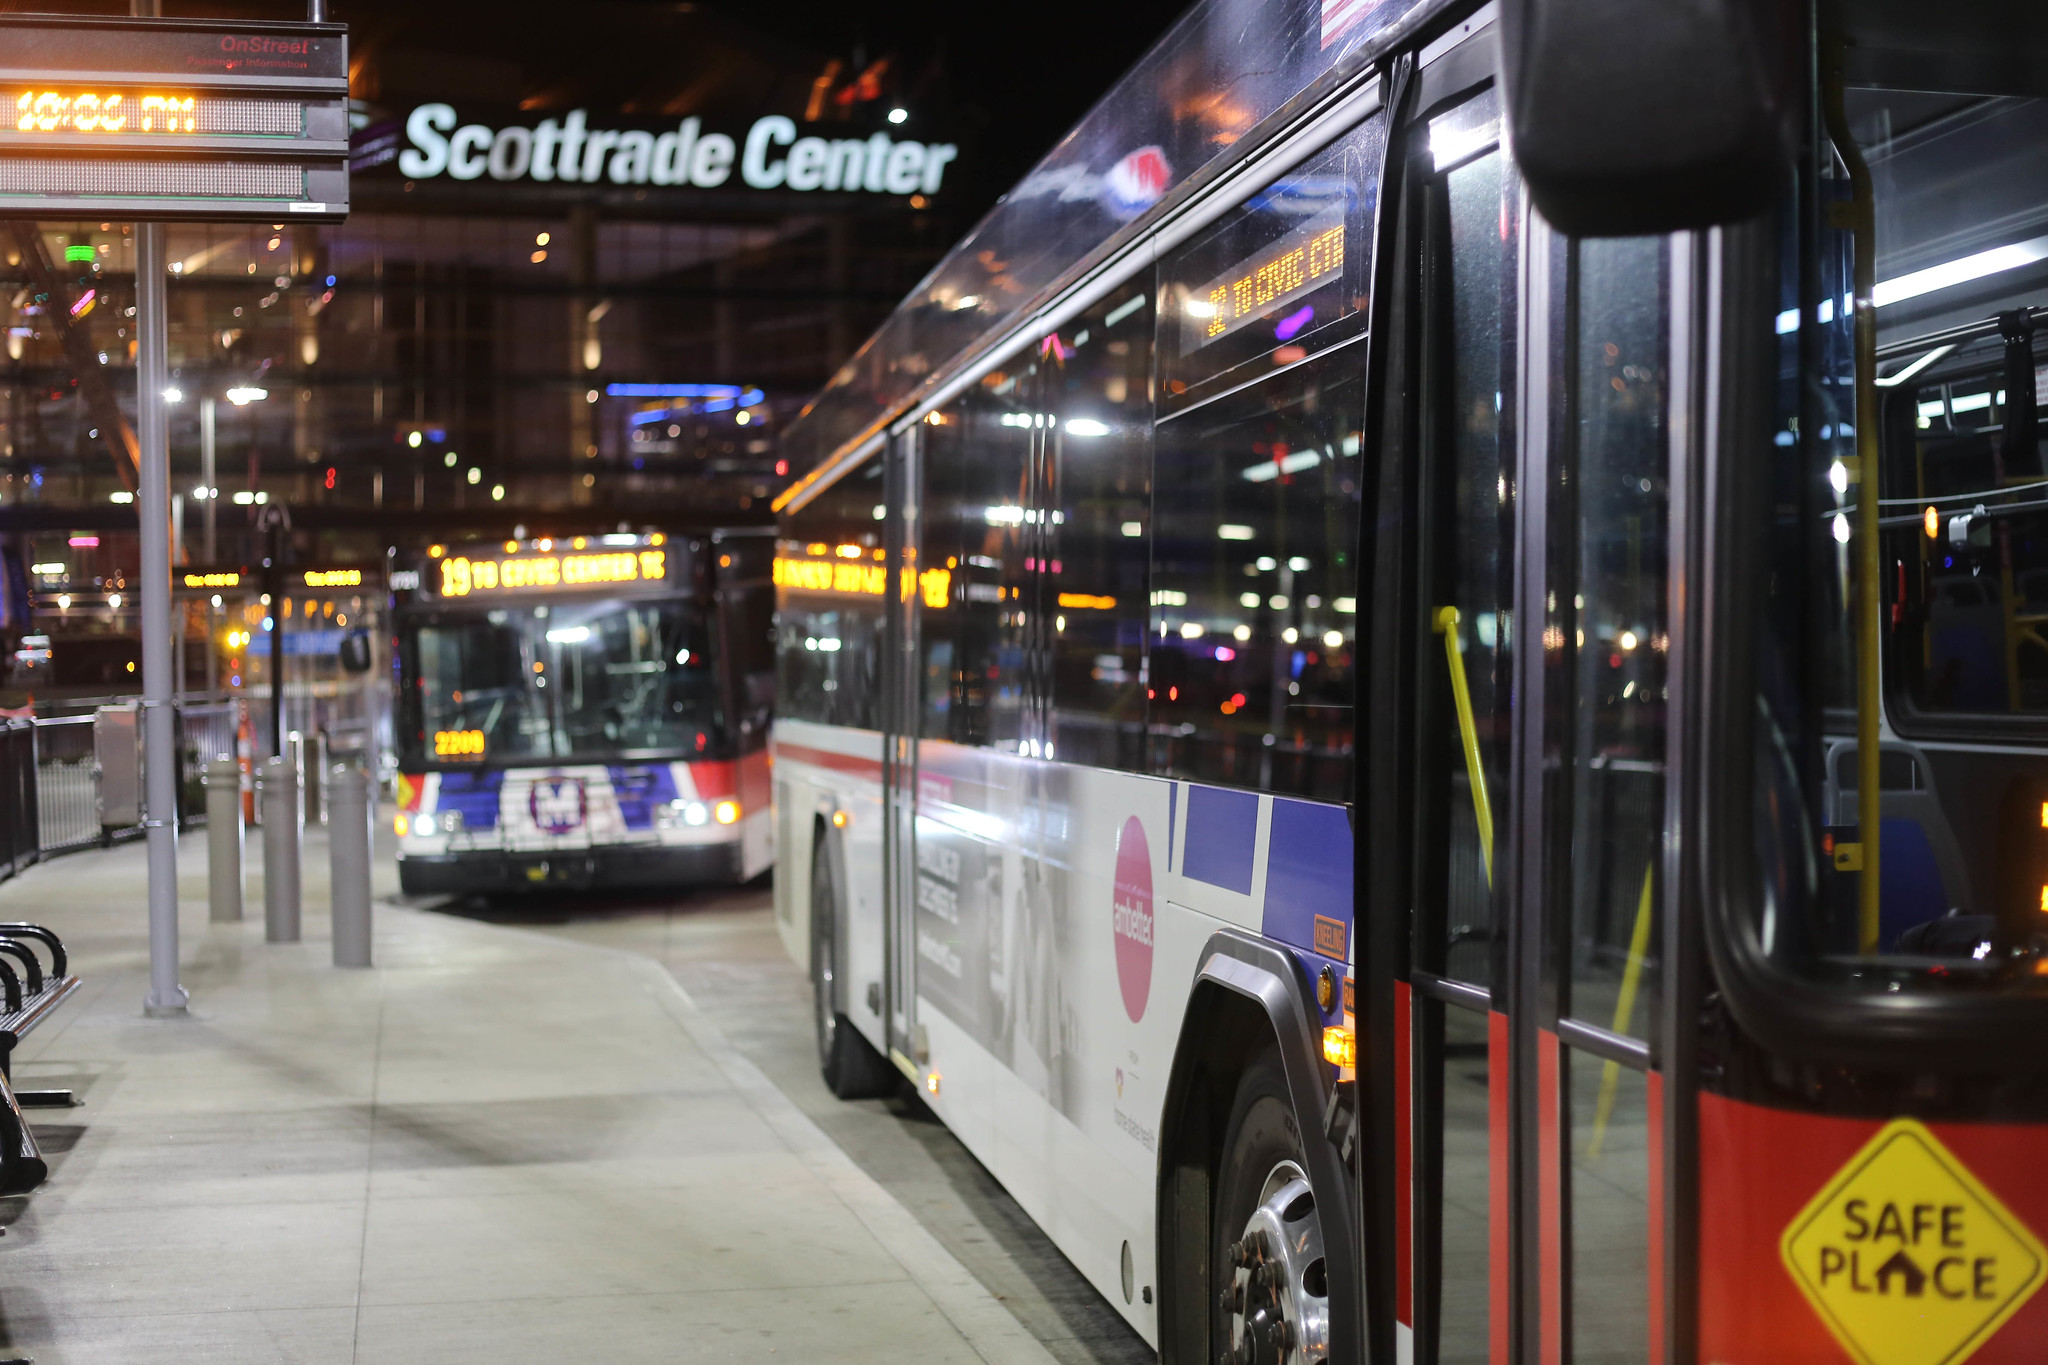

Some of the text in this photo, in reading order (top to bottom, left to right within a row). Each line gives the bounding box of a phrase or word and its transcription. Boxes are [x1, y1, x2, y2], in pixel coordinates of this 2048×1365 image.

[187, 55, 308, 69] Passenger Information
[220, 36, 309, 54] OnStreet
[399, 103, 958, 194] Scottrade Center
[1233, 275, 1252, 318] TO
[1256, 247, 1304, 305] CIVIC
[1310, 224, 1343, 278] CTR
[441, 557, 471, 596] 19
[562, 552, 638, 583] CENTER
[1316, 921, 1344, 955] KNEELING
[1844, 1199, 1965, 1248] SAFE
